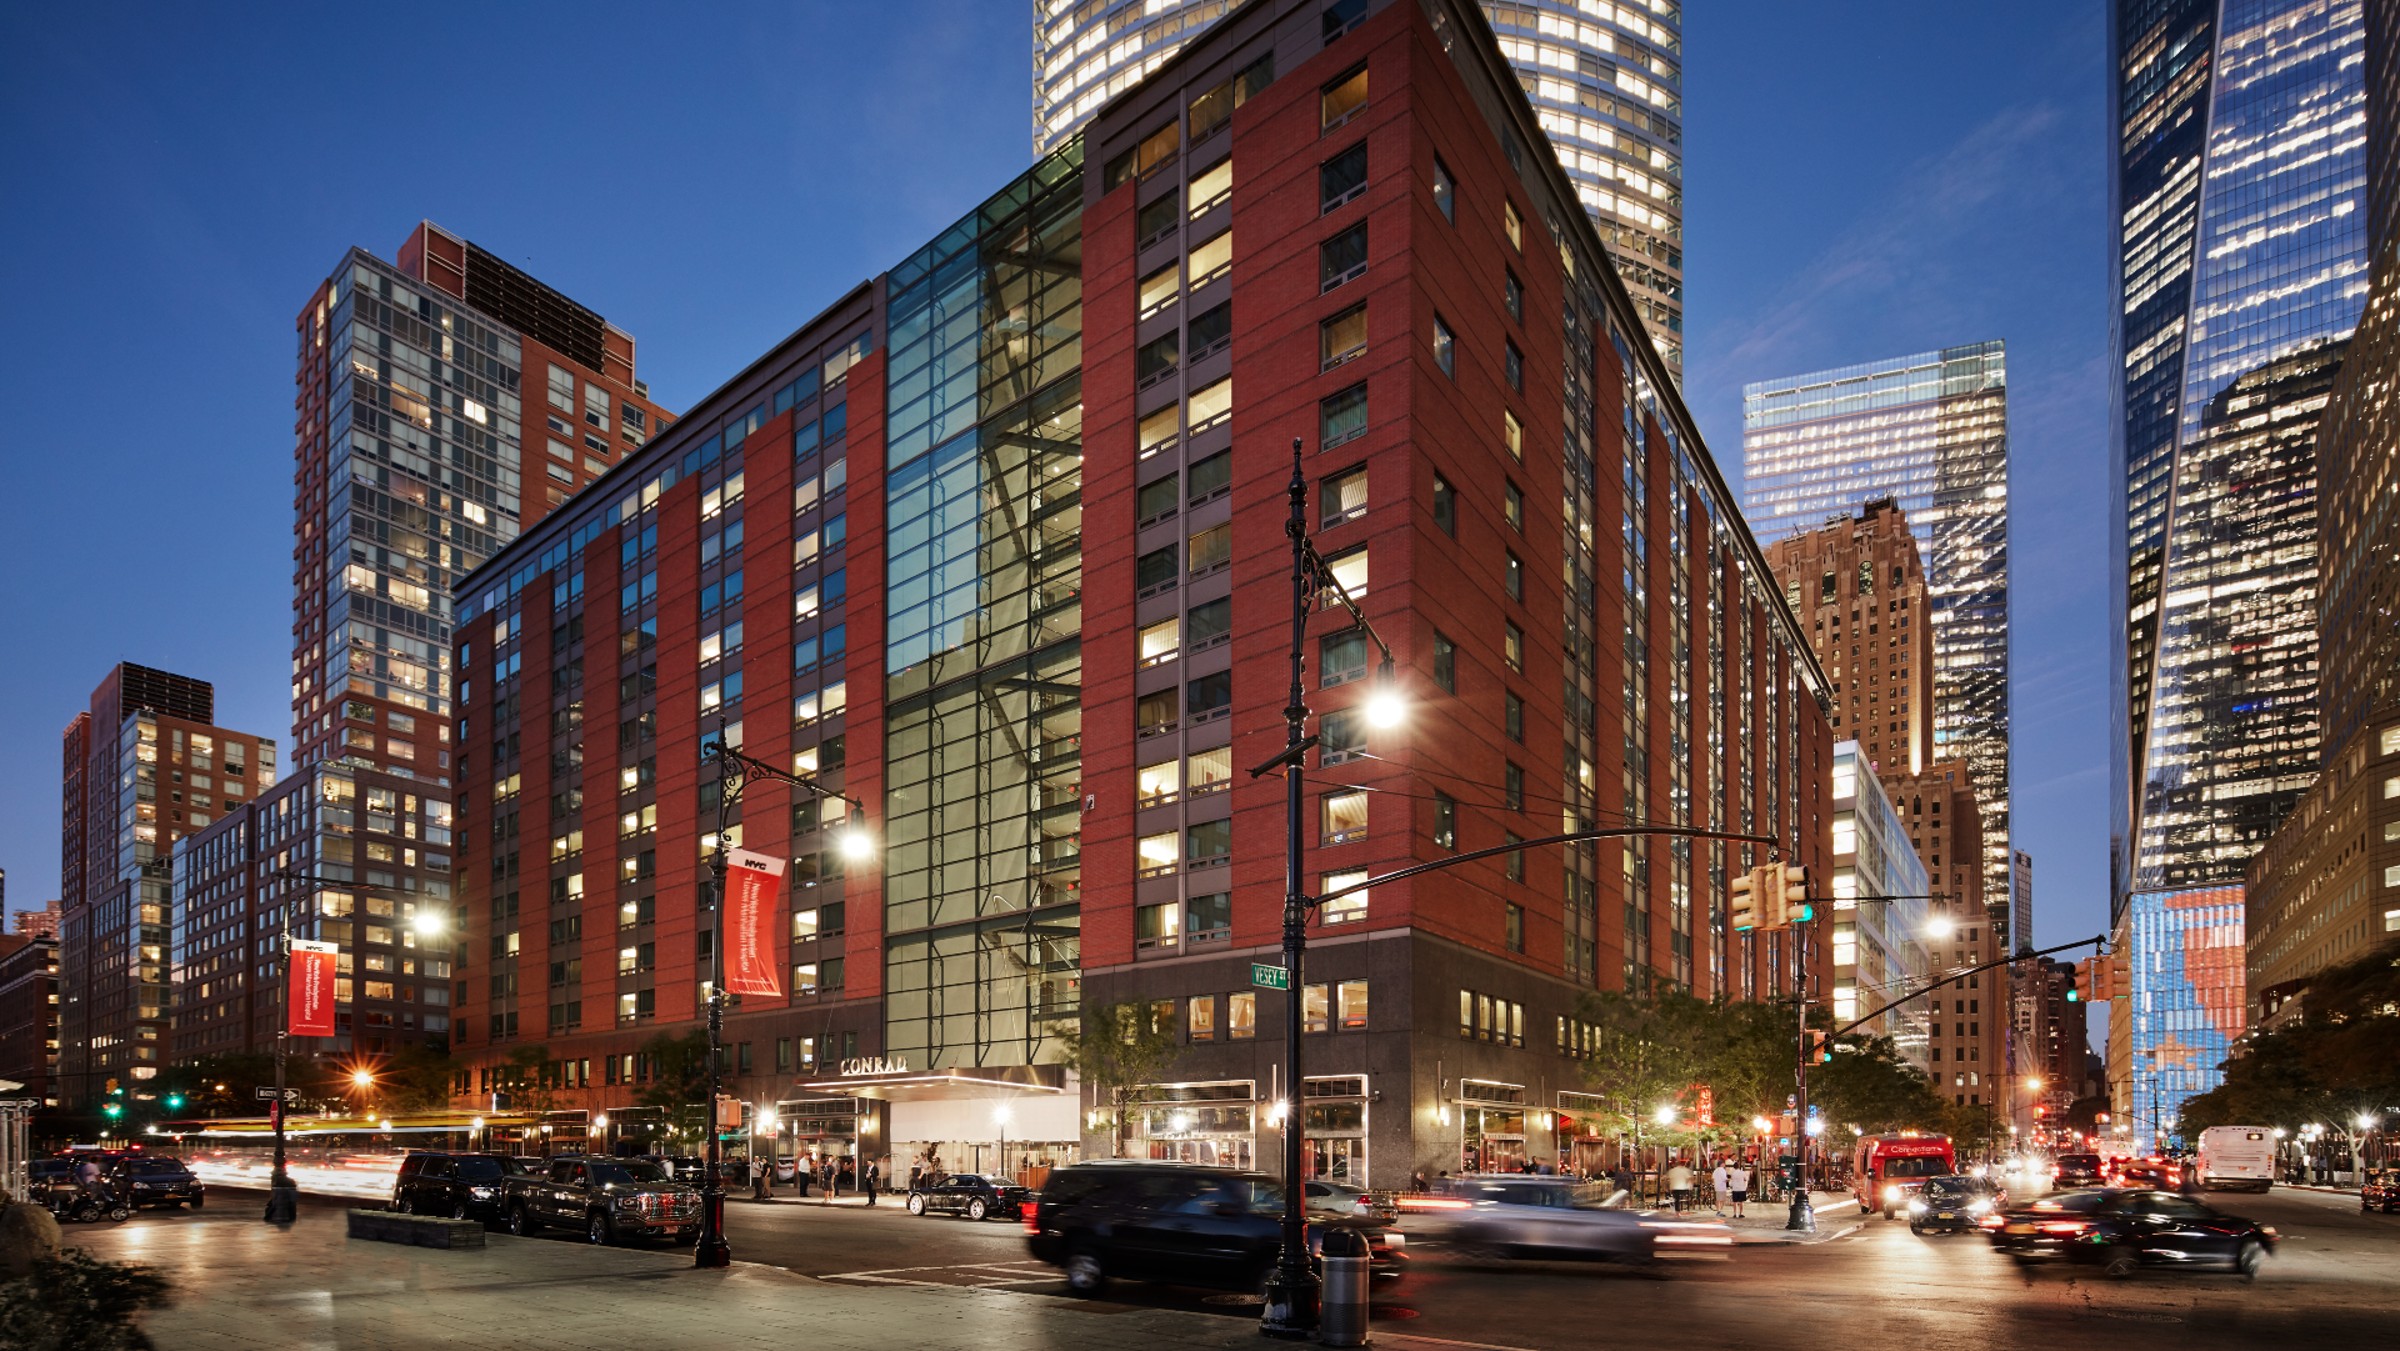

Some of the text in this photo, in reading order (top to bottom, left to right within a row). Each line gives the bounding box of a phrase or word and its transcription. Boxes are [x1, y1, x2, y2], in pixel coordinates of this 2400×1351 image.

[745, 859, 767, 870] NYC
[740, 903, 751, 942] Manhattan
[740, 944, 750, 973] Hospital
[305, 973, 313, 1000] Manhattan
[1255, 966, 1278, 986] VESEY
[304, 1000, 312, 1021] Hospital
[840, 1055, 908, 1076] CONRAD
[1890, 1145, 1936, 1153] Connection
